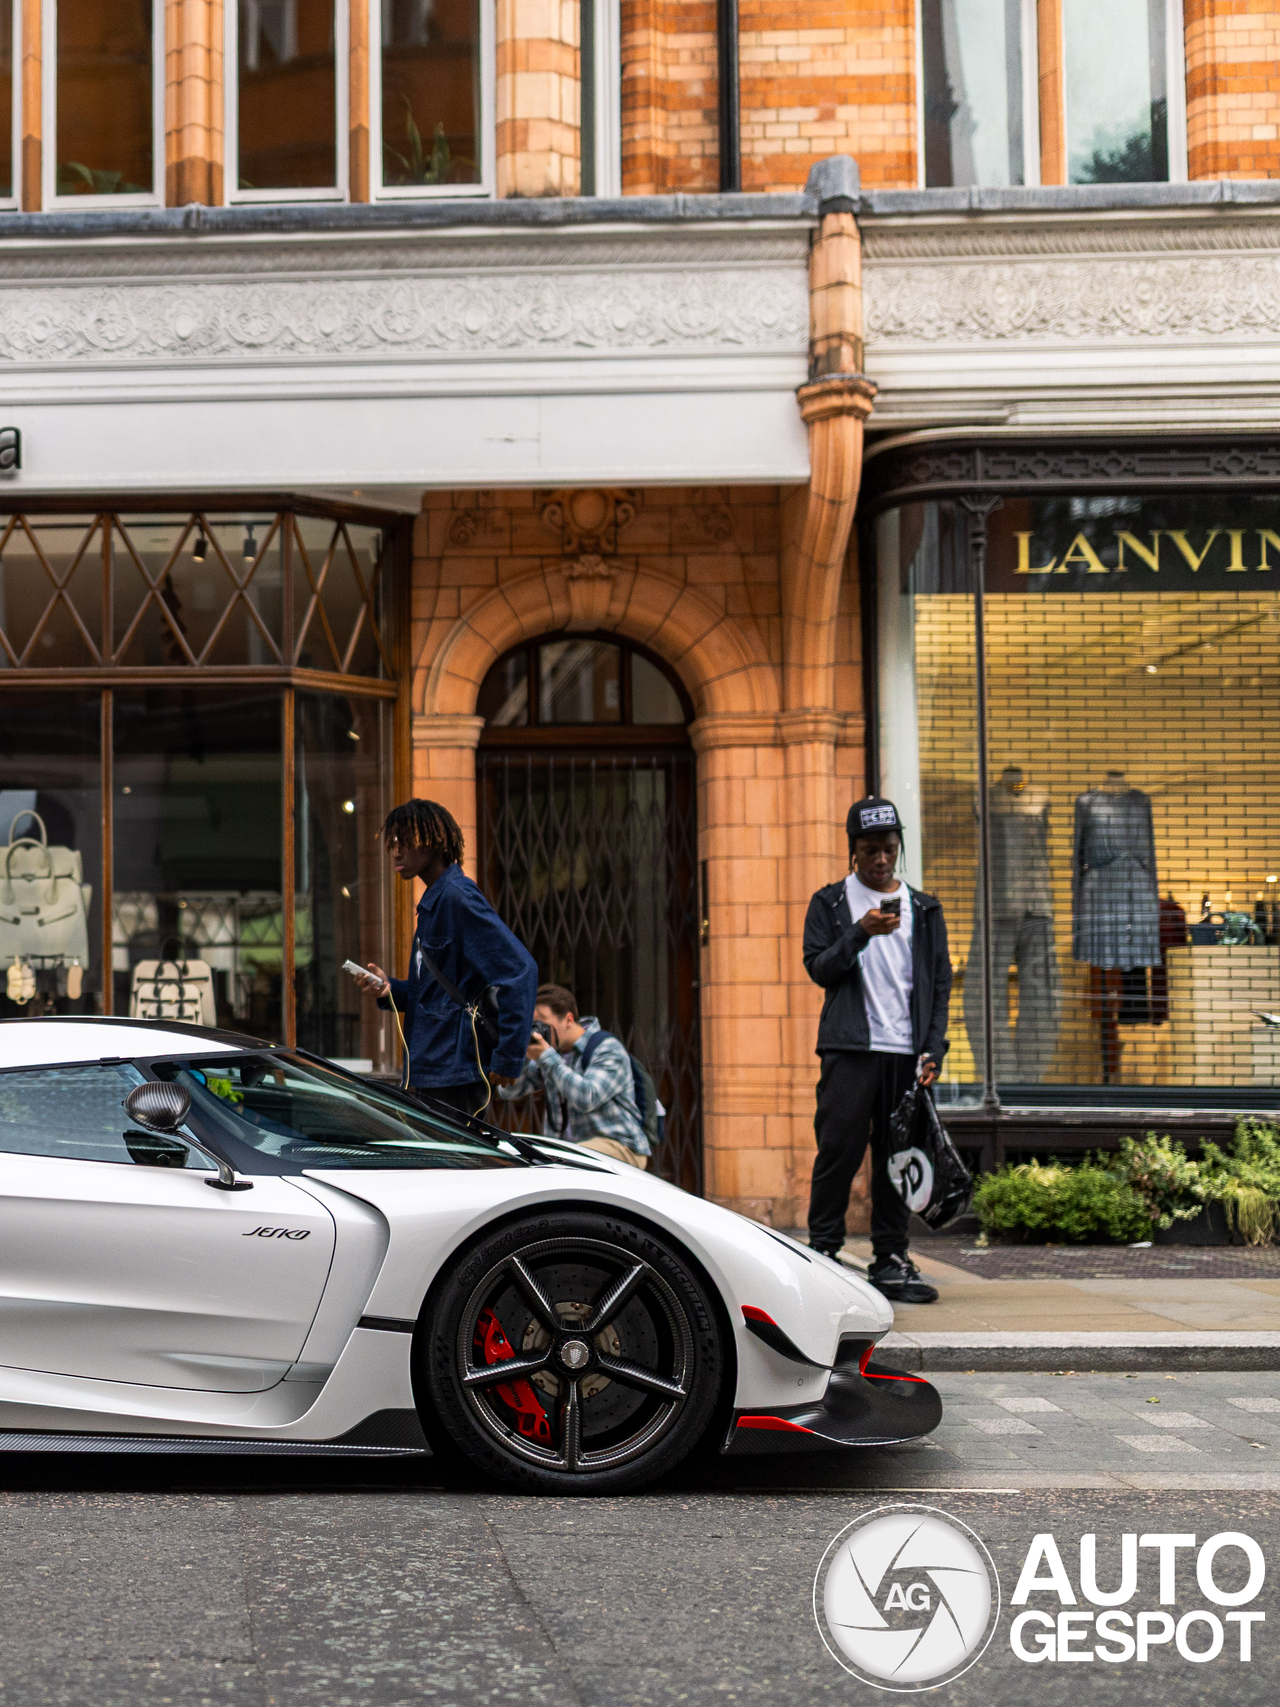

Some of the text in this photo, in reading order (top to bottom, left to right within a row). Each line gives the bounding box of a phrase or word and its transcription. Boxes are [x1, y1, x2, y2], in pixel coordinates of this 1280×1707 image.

[480, 1232, 513, 1261] Sport
[513, 1224, 536, 1238] Cup
[539, 1219, 549, 1229] 2
[660, 1254, 711, 1331] MICHELIN
